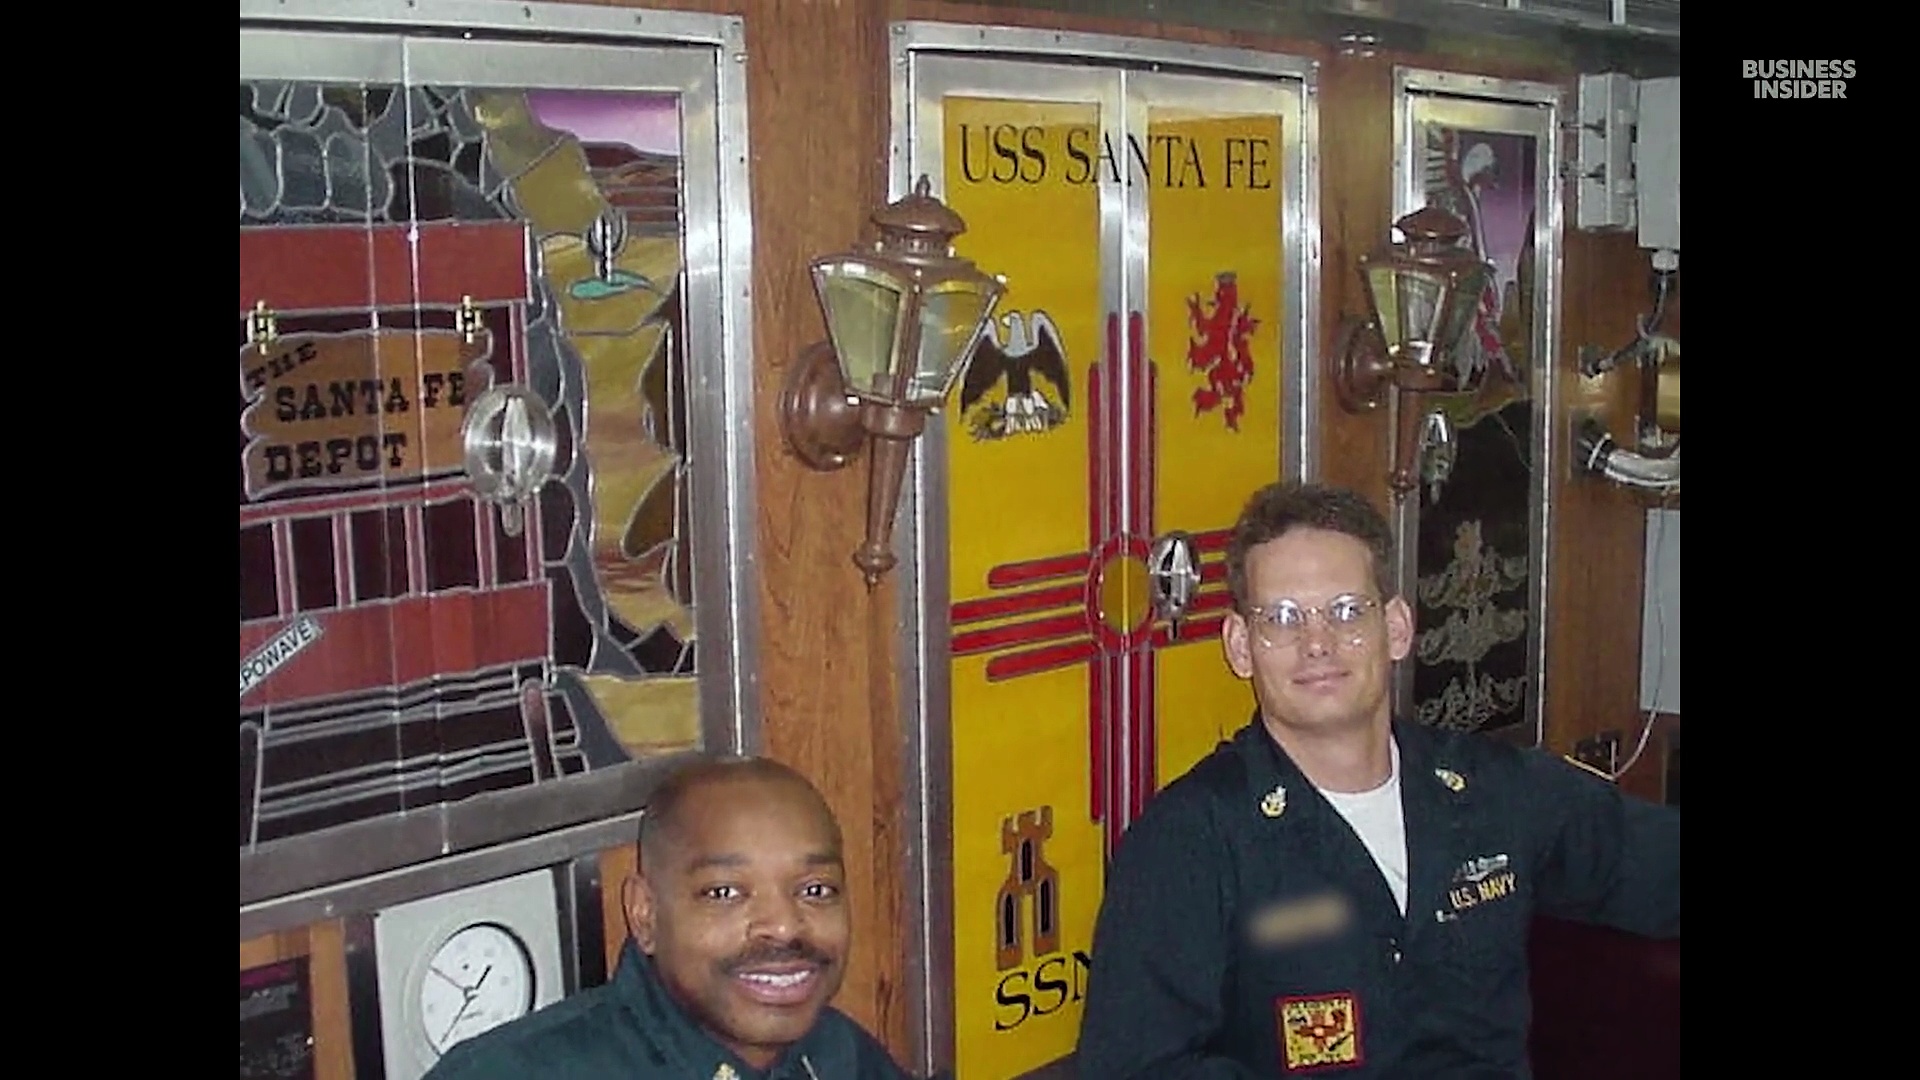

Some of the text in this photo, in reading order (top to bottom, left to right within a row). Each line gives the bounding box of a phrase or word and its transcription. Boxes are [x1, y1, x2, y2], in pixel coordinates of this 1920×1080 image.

[959, 123, 1270, 189] USS SANTA FE
[245, 341, 317, 388] THE
[276, 371, 464, 422] SANTA FE
[265, 432, 407, 480] DEPOT
[240, 616, 312, 691] POWAVE
[1477, 871, 1517, 902] NAVY
